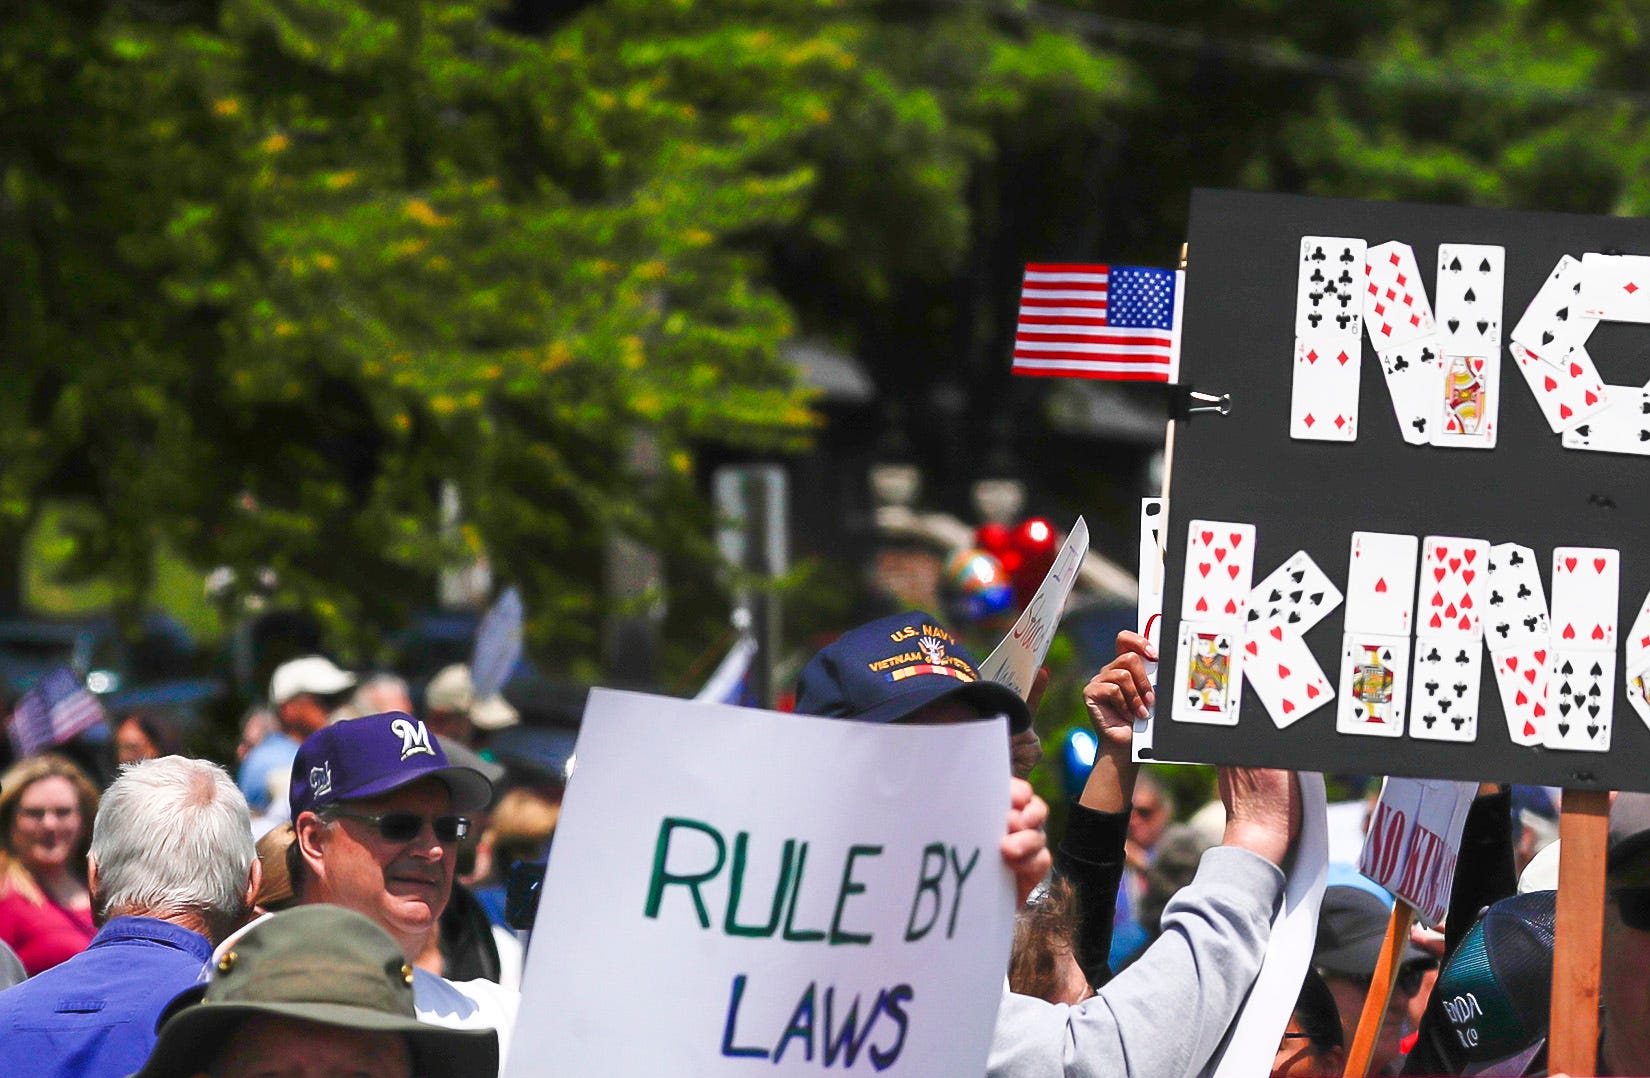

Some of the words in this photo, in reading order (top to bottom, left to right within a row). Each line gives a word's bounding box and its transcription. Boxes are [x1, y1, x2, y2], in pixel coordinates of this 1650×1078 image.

[868, 651, 923, 672] VIETNAM
[890, 625, 920, 643] U.S.
[643, 816, 884, 946] RULE
[905, 841, 981, 943] BY
[1359, 801, 1406, 886] NO
[722, 973, 915, 1073] LAWS
